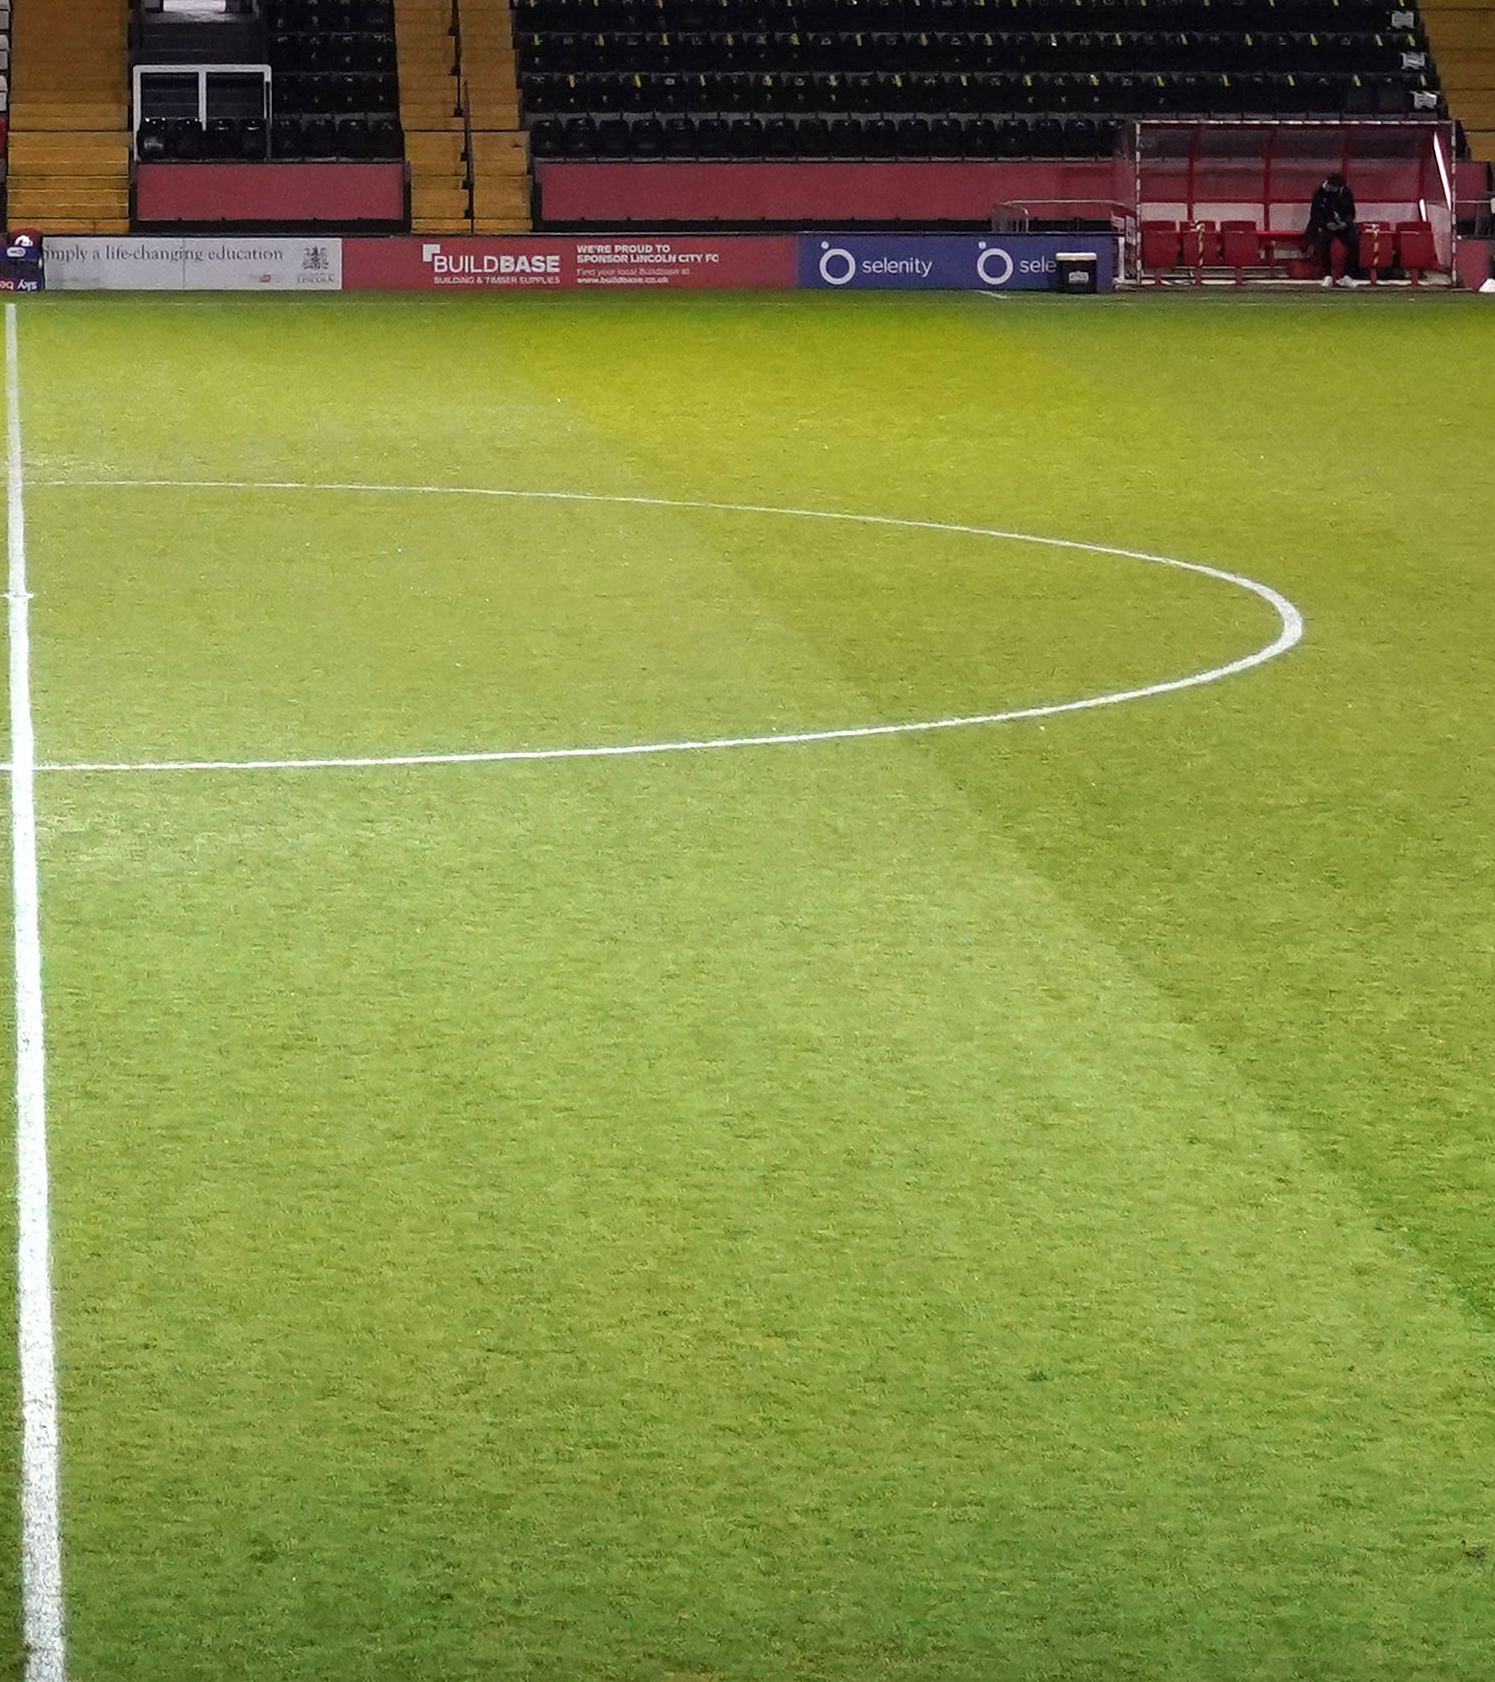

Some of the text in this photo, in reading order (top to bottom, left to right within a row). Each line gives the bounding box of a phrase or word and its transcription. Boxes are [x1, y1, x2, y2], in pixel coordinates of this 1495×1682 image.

[92, 250, 101, 261] a
[105, 244, 204, 264] life-changing
[208, 246, 284, 262] education
[614, 243, 652, 254] PROUD
[655, 243, 671, 254] TO
[434, 255, 561, 274] BUILDBASE
[576, 253, 628, 264] SPONSOR
[630, 253, 676, 264] LINCOLN
[678, 253, 702, 263] CITY
[861, 256, 933, 278] selenity
[1019, 256, 1057, 274] sele
